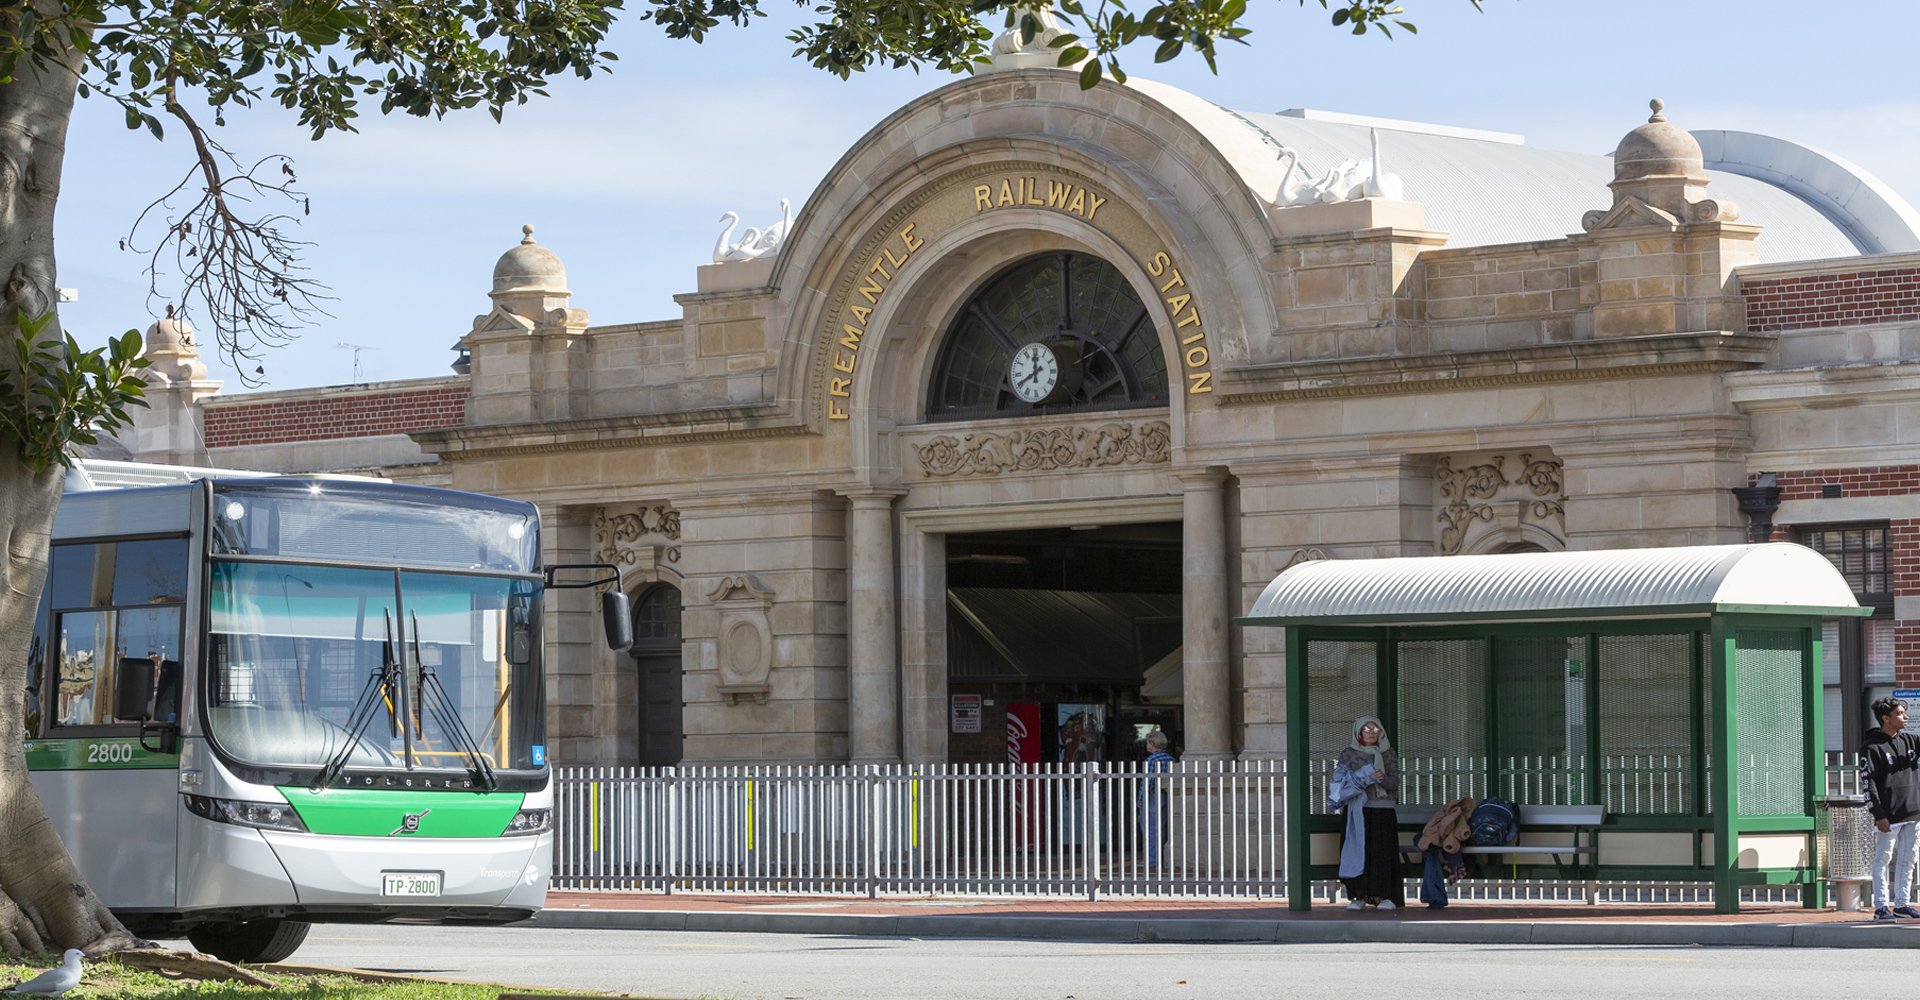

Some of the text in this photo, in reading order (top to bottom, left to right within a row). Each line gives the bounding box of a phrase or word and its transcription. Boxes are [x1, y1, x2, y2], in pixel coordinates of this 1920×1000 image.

[829, 177, 1213, 421] FREMANTLE RAILWAY STATION
[87, 743, 132, 763] 2800
[344, 776, 470, 788] VOLGREN
